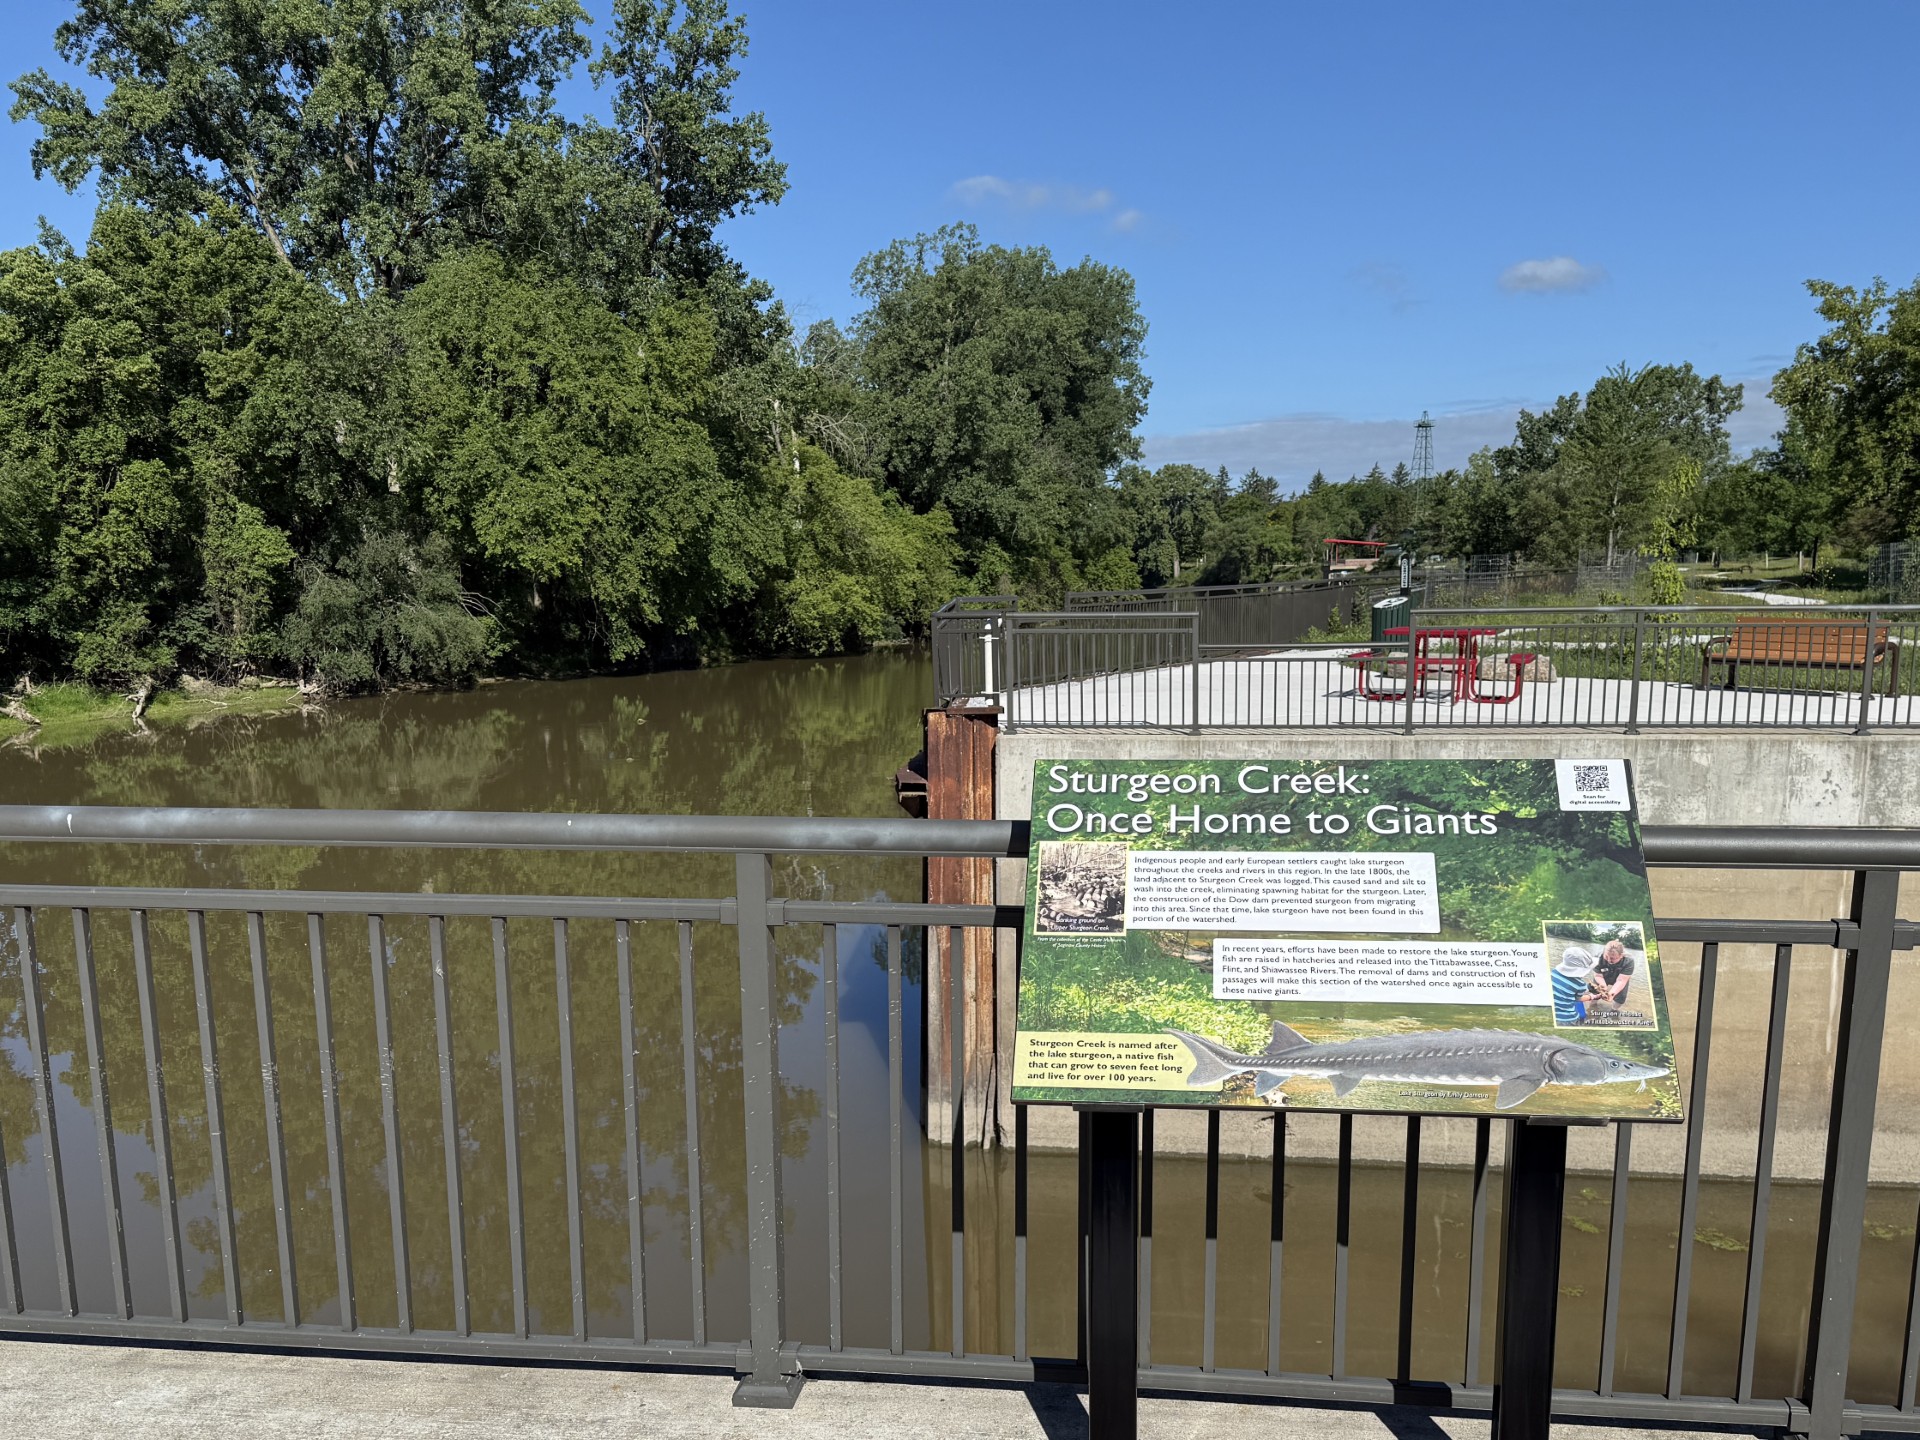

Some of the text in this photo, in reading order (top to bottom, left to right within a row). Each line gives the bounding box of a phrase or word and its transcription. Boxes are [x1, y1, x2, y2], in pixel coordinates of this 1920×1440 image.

[1048, 765, 1370, 801] Sturgeon Creek:
[1046, 804, 1497, 835] Once Home to Giants
[1134, 857, 1176, 865] Indigenous
[1180, 857, 1206, 866] people
[1225, 857, 1244, 866] early
[1247, 857, 1285, 866] European
[1320, 858, 1346, 866] caught
[1368, 858, 1404, 867] sturgeon
[1134, 866, 1178, 875] throughout
[1295, 867, 1322, 876] region.
[1152, 876, 1185, 885] adjacent
[1199, 876, 1235, 885] Sturgeon
[1284, 877, 1312, 886] logged.
[1216, 886, 1259, 895] eliminating
[1262, 887, 1298, 896] spawning
[1362, 888, 1400, 897] sturgeon.
[1271, 896, 1312, 905] prevented
[1315, 897, 1351, 905] sturgeon
[1377, 897, 1415, 906] migrating
[1470, 949, 1510, 957] sturgeon.
[1512, 949, 1538, 958] Young
[1453, 980, 1474, 989] again
[1275, 987, 1300, 996] giants.
[1030, 1040, 1073, 1049] Sturgeon
[1070, 1051, 1114, 1060] sturgeon,
[1162, 1064, 1182, 1073] long
